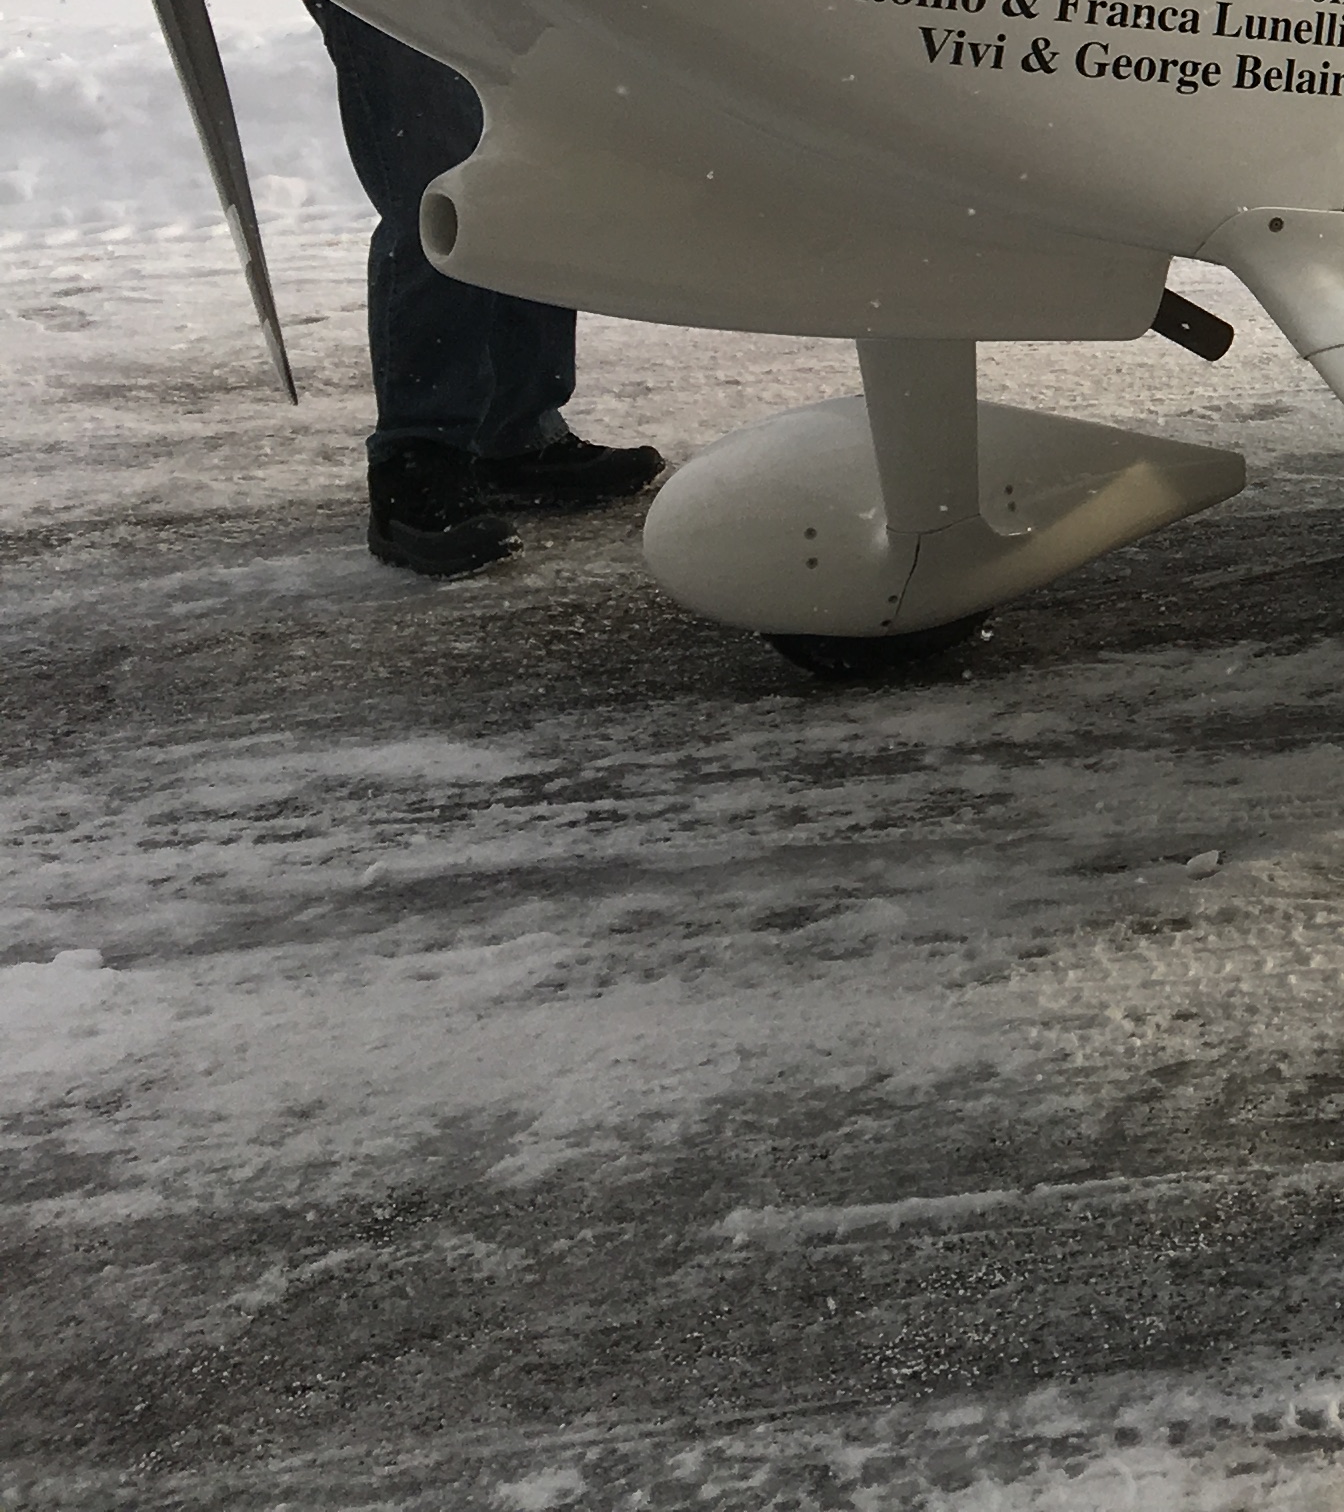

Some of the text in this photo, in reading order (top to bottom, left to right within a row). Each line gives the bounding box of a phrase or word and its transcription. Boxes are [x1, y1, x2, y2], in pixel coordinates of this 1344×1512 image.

[918, 26, 1006, 71] Vivi
[1021, 36, 1059, 74] &
[1074, 42, 1222, 94] George
